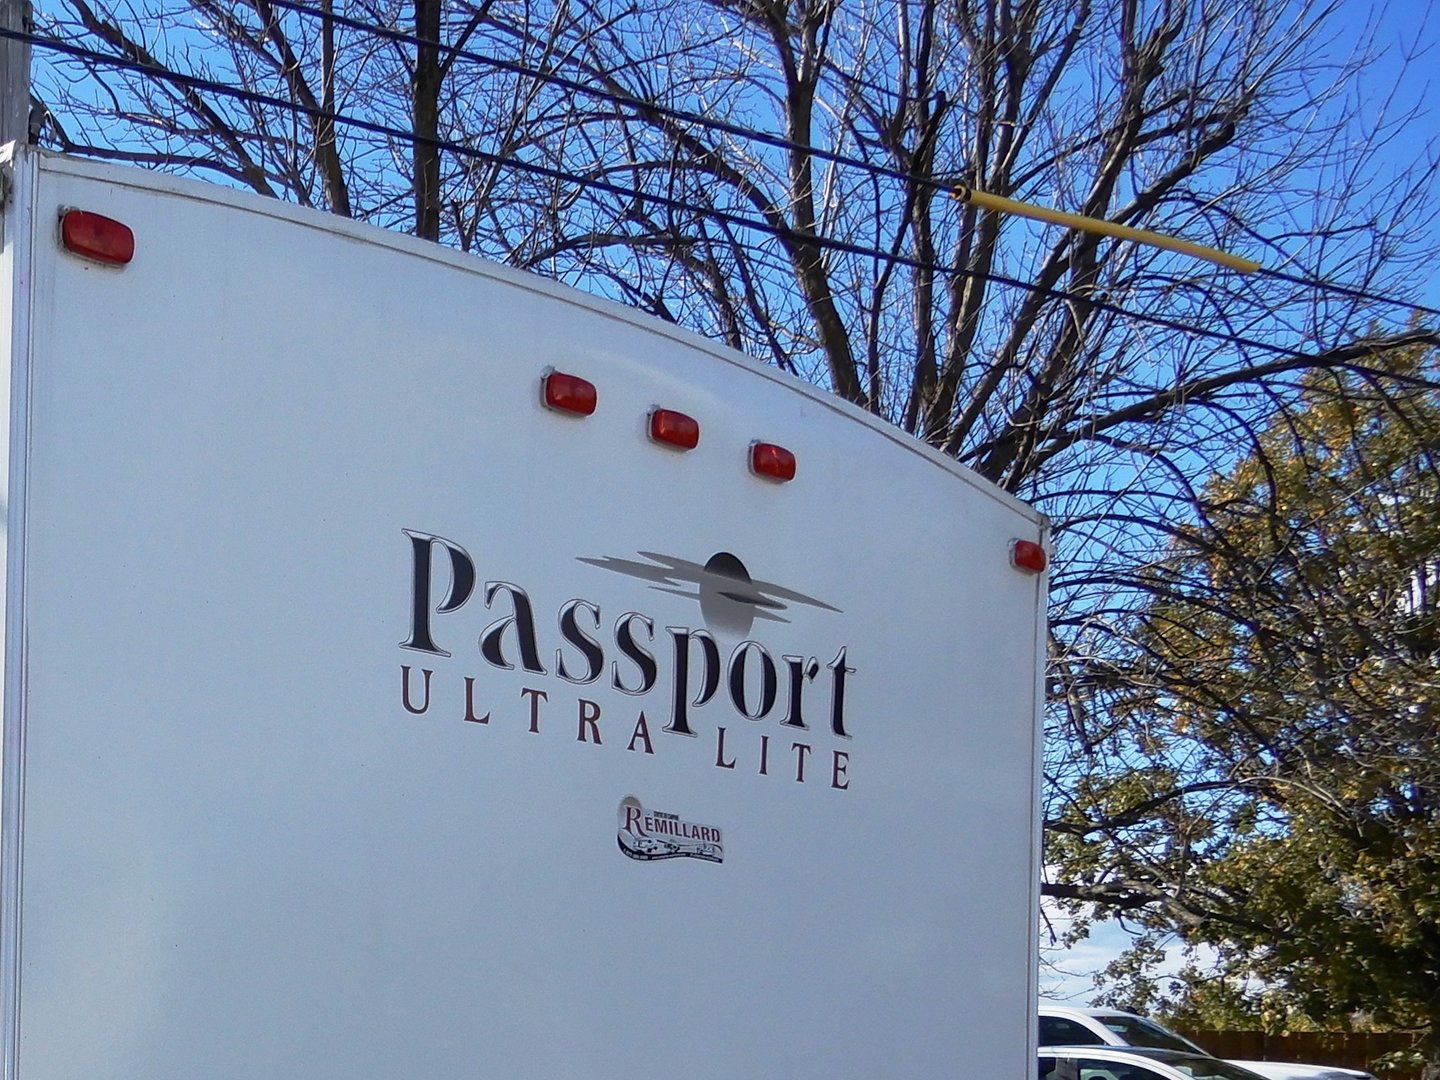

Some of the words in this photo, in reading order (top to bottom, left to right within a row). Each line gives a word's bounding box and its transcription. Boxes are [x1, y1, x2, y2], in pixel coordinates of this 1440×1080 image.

[398, 528, 857, 739] Passport
[400, 665, 655, 755] ULTRA
[715, 727, 851, 790] LITE
[623, 805, 720, 843] RÉMILLARD
